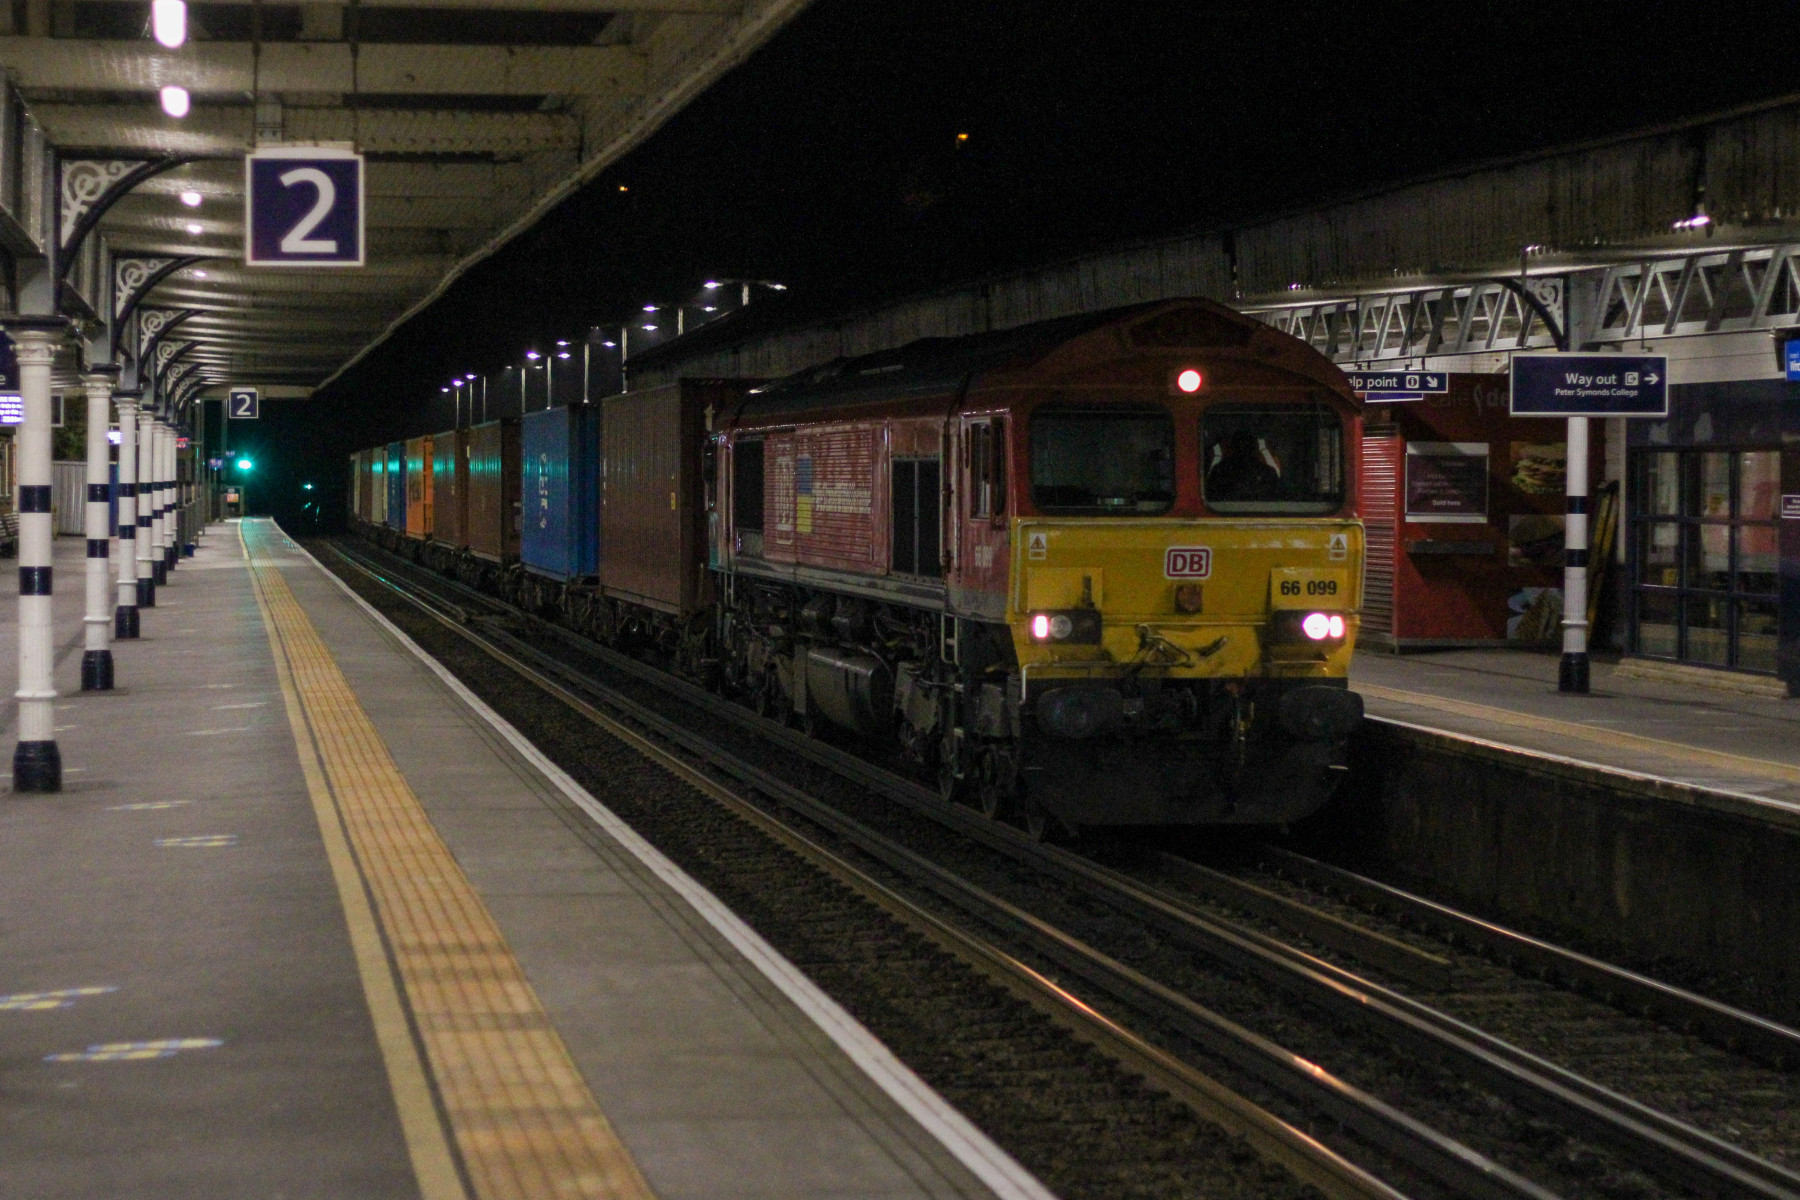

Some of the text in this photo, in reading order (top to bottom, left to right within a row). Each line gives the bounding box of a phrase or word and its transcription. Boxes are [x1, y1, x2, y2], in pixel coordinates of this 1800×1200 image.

[279, 167, 337, 253] 2
[1367, 376, 1398, 389] point
[1565, 372, 1617, 387] Way out
[1555, 388, 1639, 398] Peter Symonds College
[236, 393, 251, 416] 2
[1172, 553, 1204, 573] DB
[1280, 580, 1338, 596] 66 099
